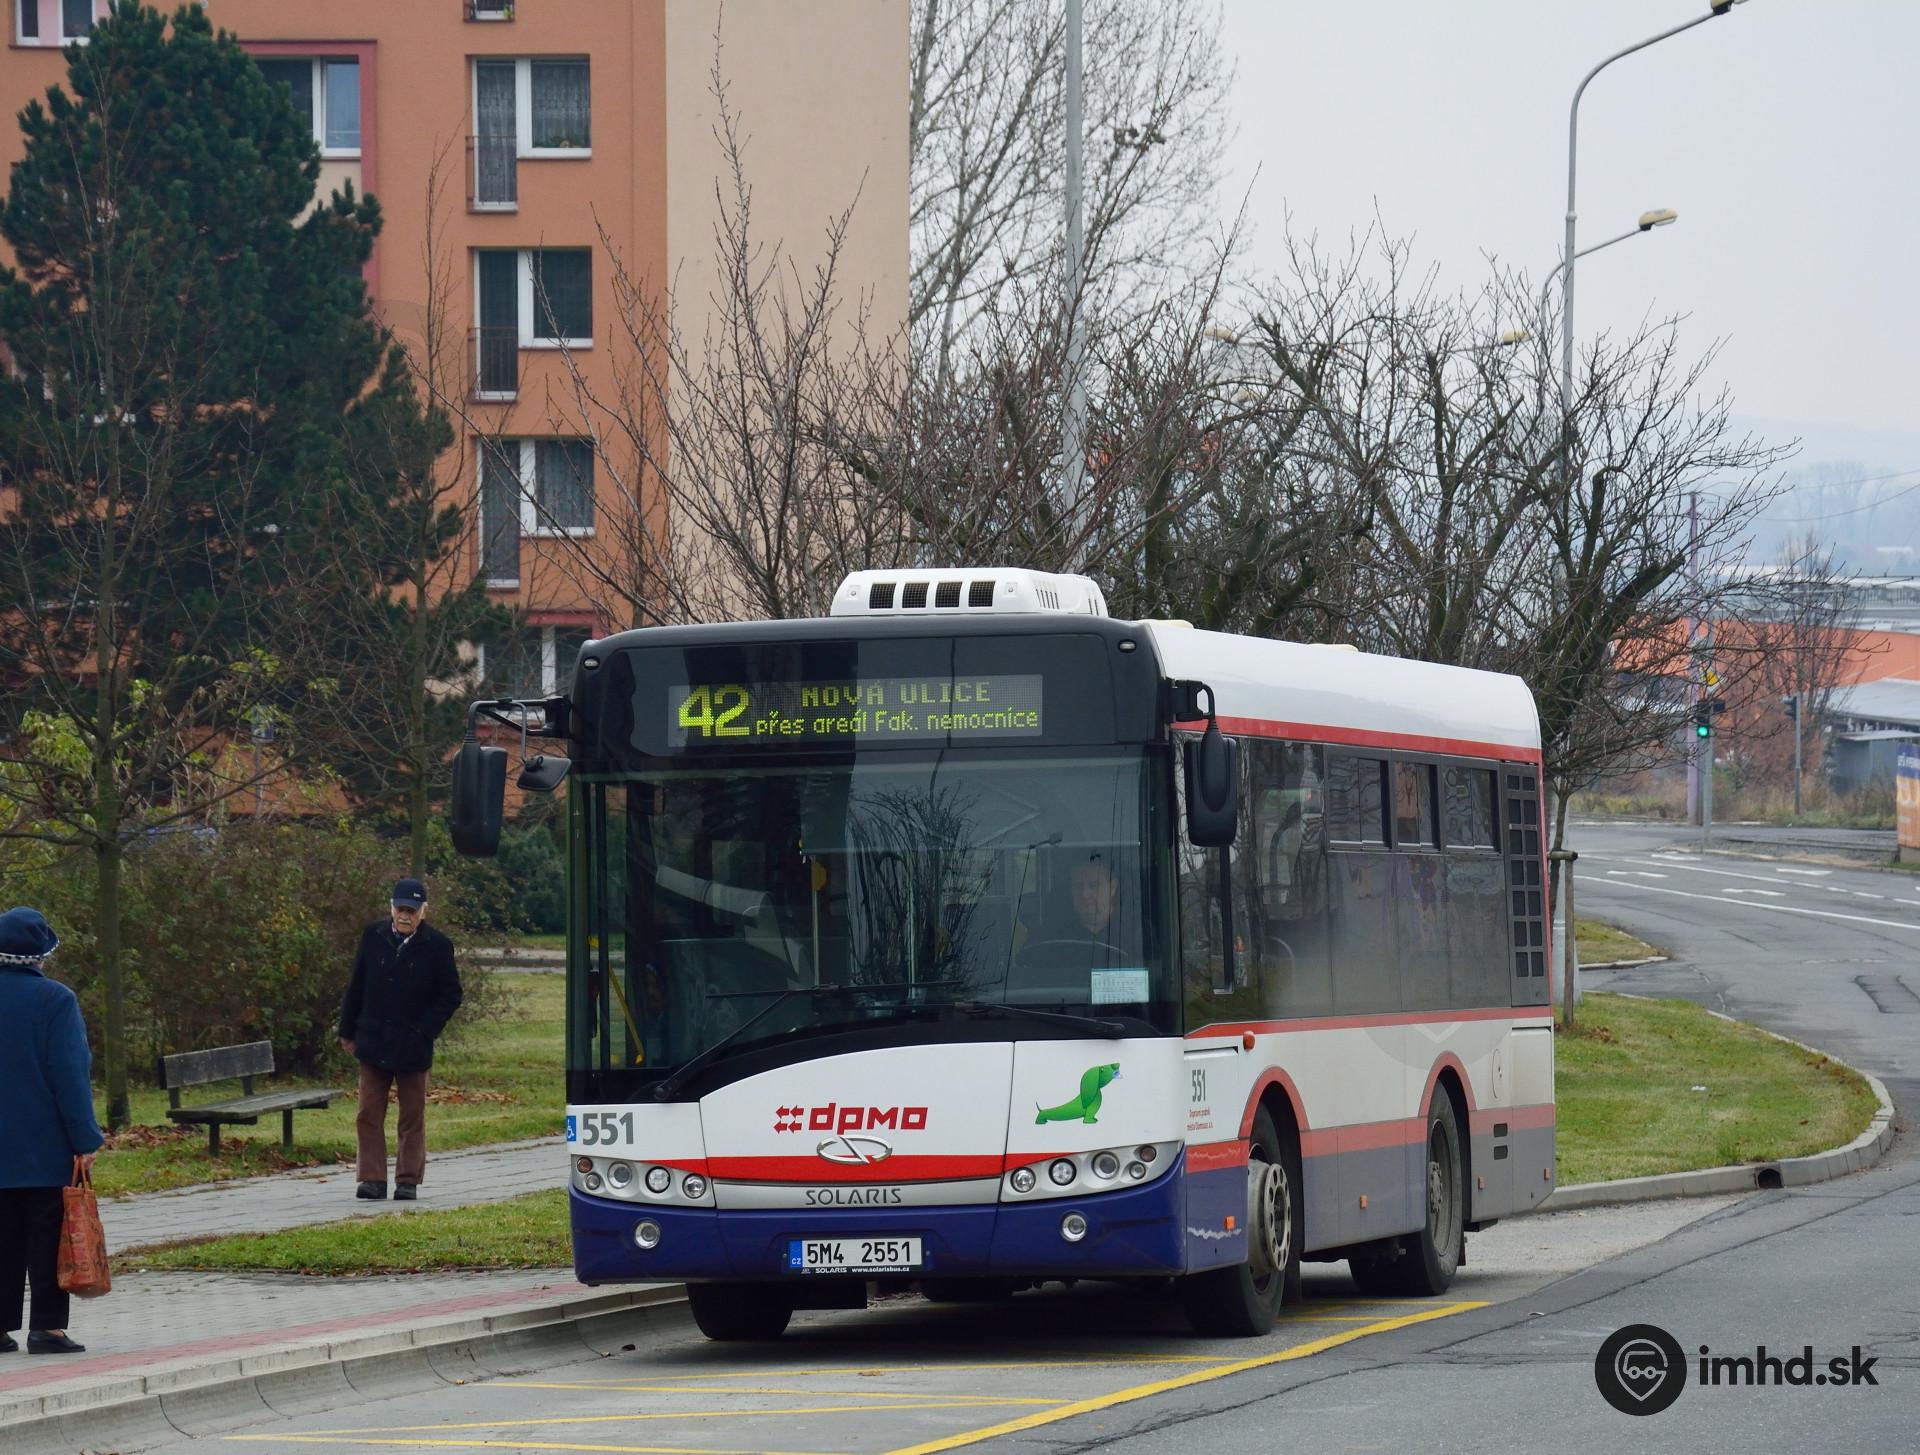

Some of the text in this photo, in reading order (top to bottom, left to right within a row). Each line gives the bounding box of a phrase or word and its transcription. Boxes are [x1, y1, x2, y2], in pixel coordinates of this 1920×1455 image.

[802, 680, 991, 707] NOVÁ ULICE
[678, 684, 750, 737] 42
[756, 710, 804, 735] přes
[813, 708, 867, 734] areál
[875, 709, 919, 732] Fak.
[1191, 1069, 1206, 1102] 551
[582, 1112, 634, 1146] 551
[805, 1188, 902, 1206] SOLARIS
[791, 1257, 802, 1265] CZ
[806, 1241, 911, 1264] 5M4 2551
[851, 1265, 910, 1273] www.solarisbus.cz
